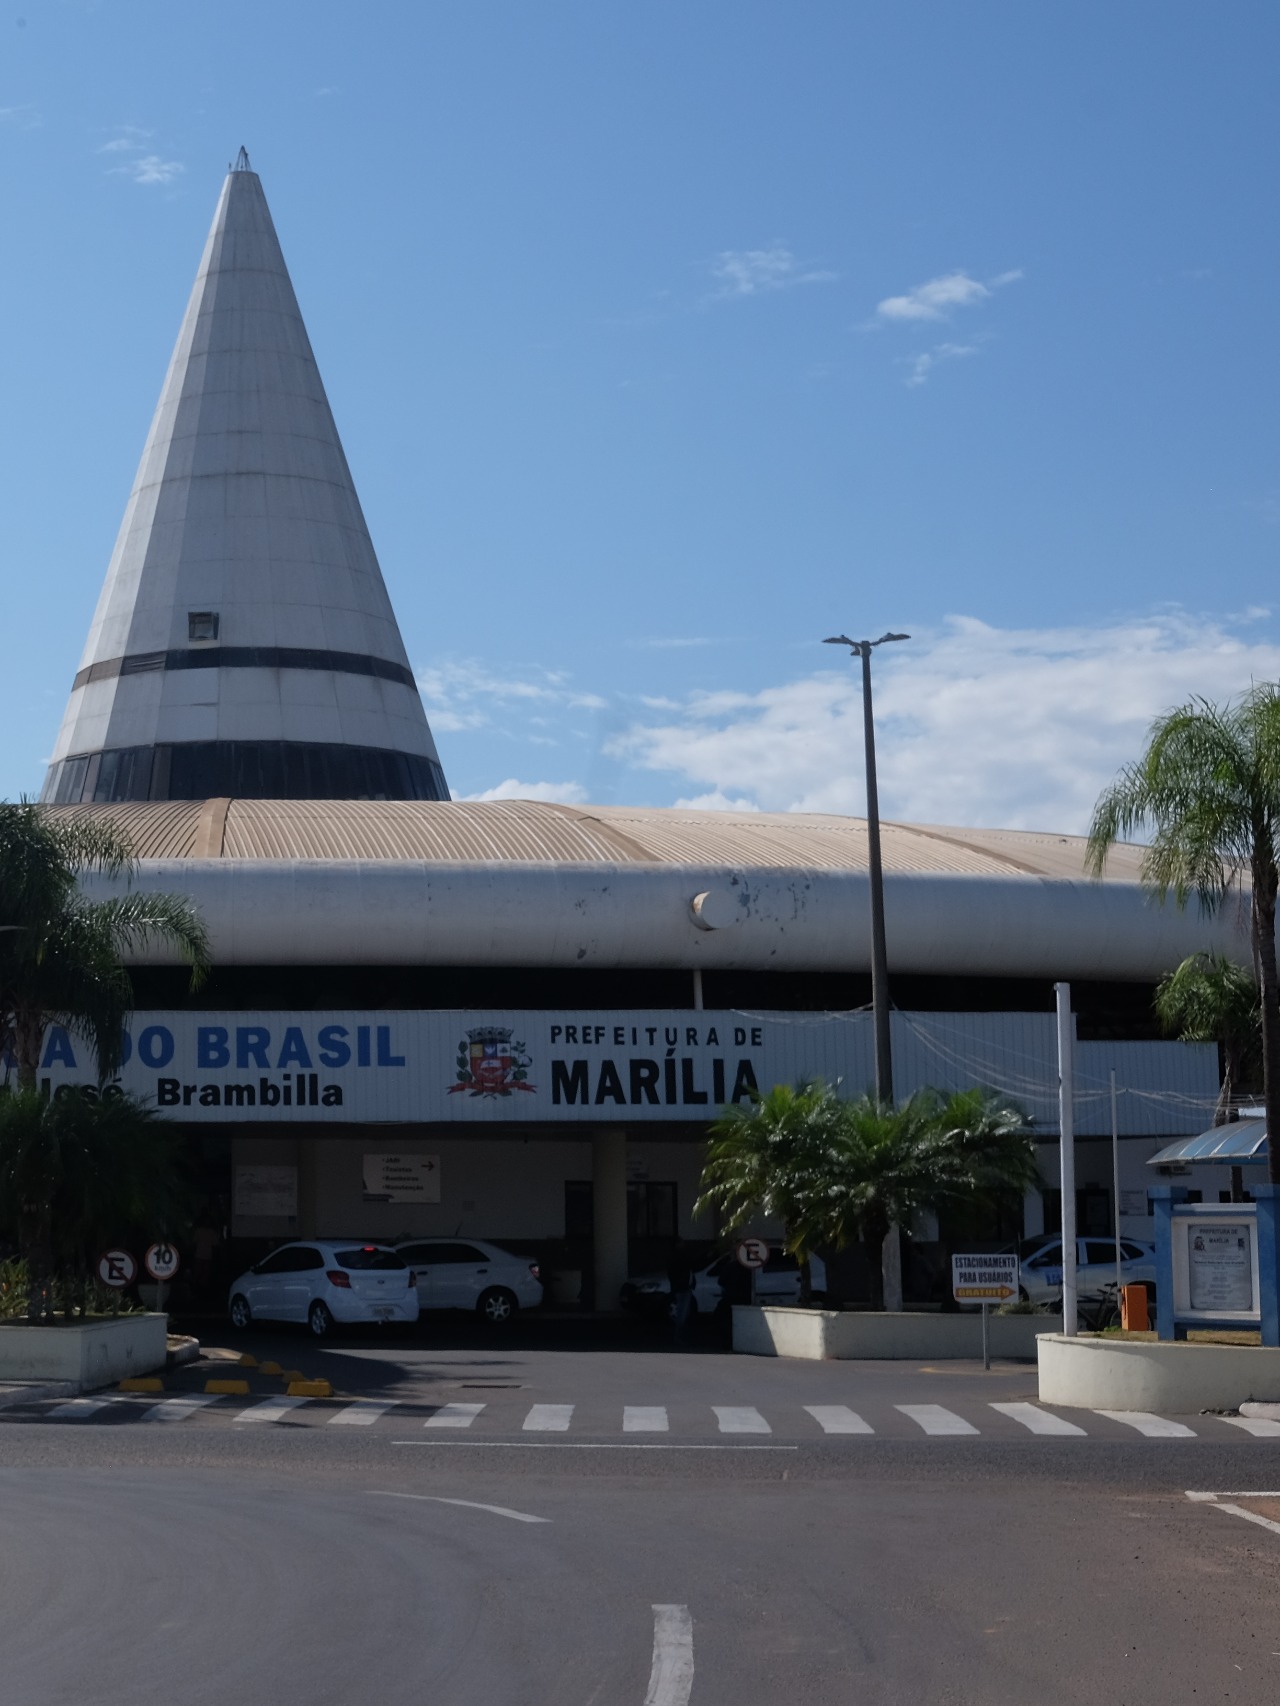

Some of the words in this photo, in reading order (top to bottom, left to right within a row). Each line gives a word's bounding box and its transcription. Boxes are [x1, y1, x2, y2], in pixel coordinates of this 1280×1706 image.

[197, 1024, 406, 1069] BRASIL
[550, 1025, 720, 1047] PREFEITURA
[734, 1027, 763, 1046] DE
[551, 1047, 761, 1105] MARÍLIA
[157, 1073, 344, 1106] Brambilla
[153, 1247, 173, 1265] 10
[955, 1257, 1016, 1268] ESTACIONAMENTO
[959, 1271, 977, 1283] PARA
[978, 1269, 1013, 1283] USUÁRIOS
